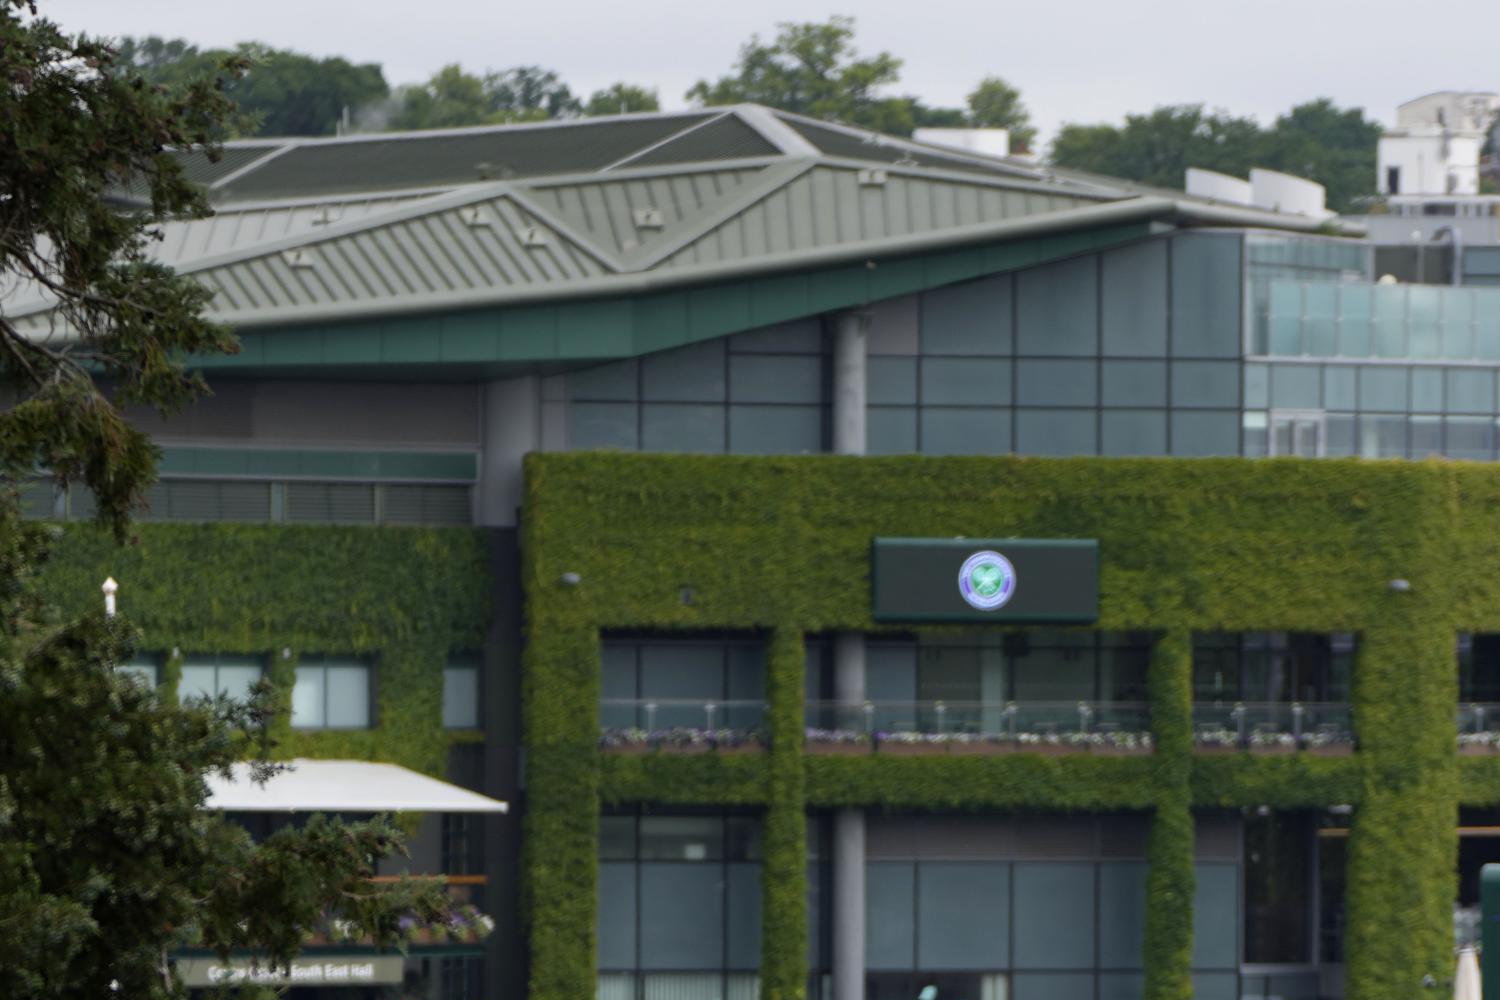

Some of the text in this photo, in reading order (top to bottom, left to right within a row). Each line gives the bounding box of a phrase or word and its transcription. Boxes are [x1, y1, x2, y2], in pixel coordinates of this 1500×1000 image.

[290, 964, 322, 979] South
[325, 963, 348, 978] East
[351, 963, 374, 978] Hall
